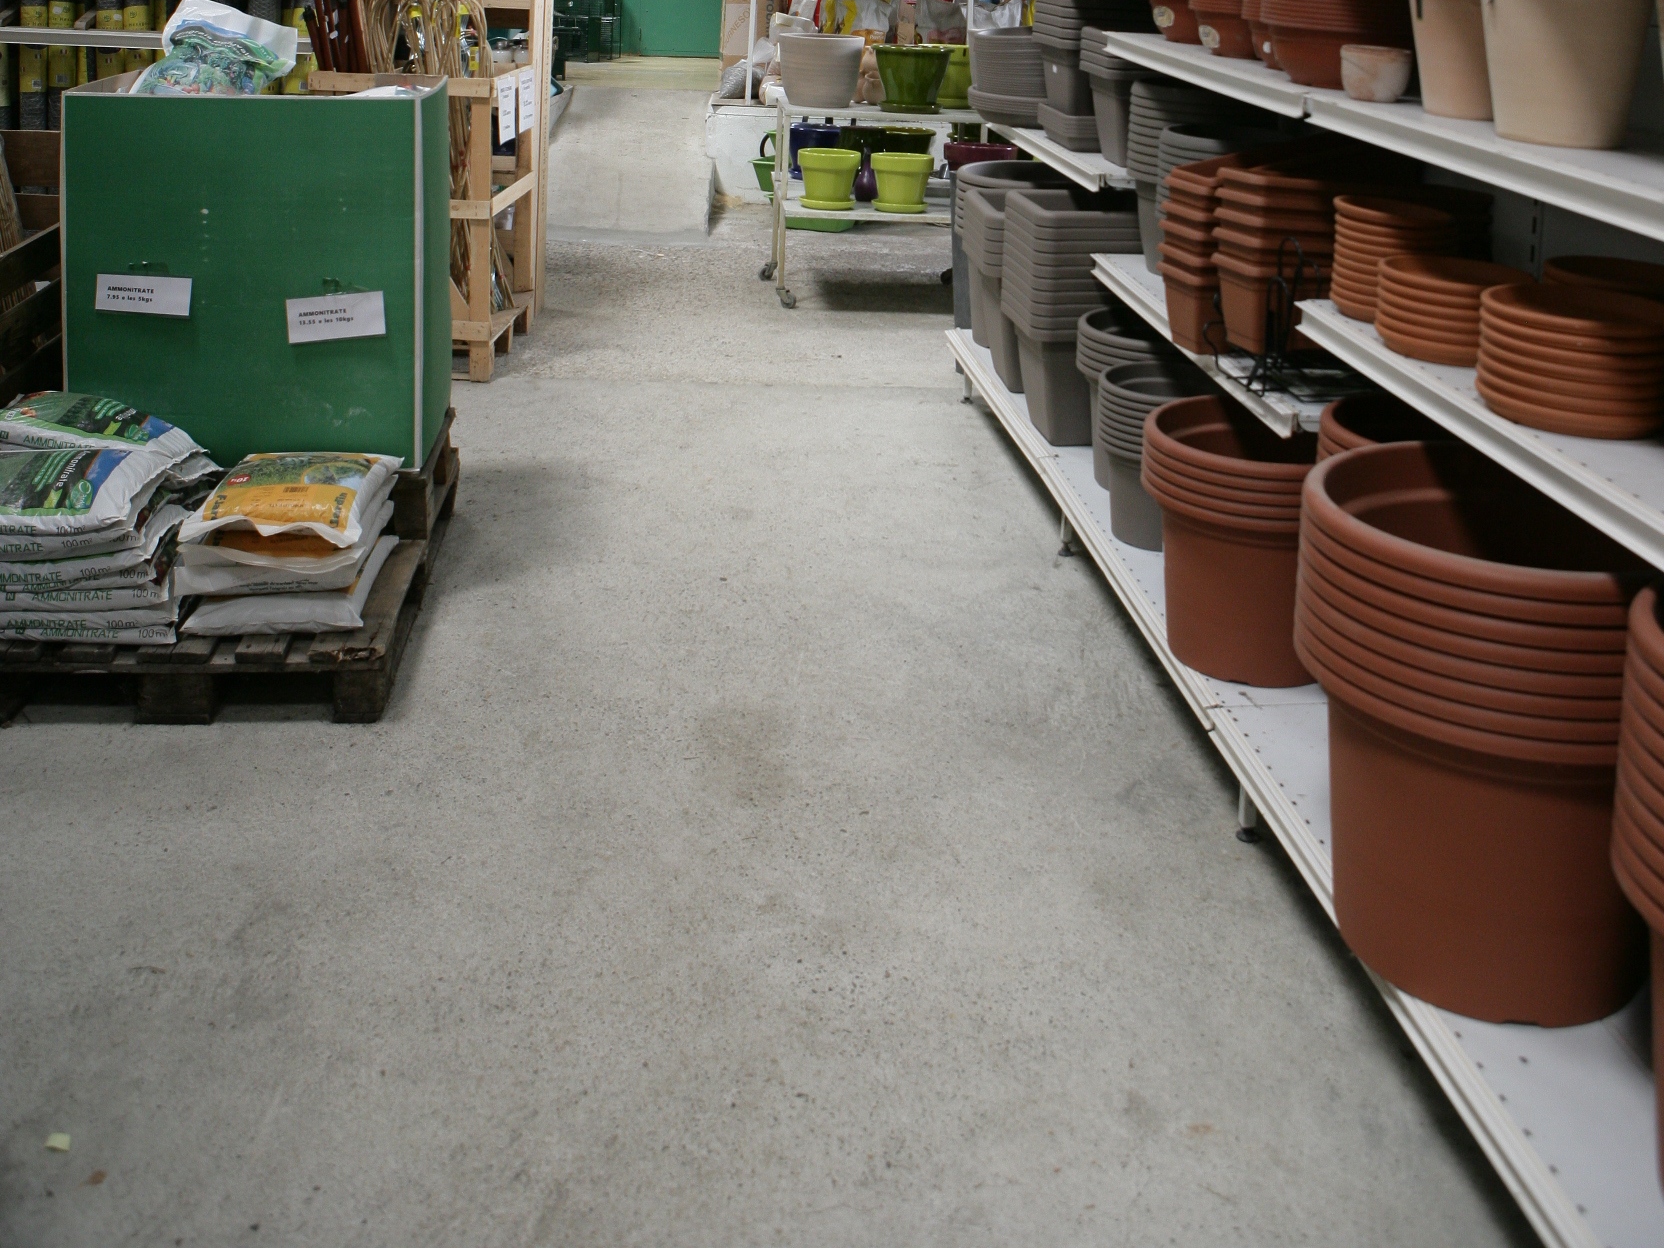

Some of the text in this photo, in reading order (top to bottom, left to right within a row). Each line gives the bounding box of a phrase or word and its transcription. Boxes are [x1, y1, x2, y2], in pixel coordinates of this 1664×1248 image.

[107, 285, 155, 294] AMMONITRATE
[298, 308, 347, 318] AMMONITRATE
[23, 435, 95, 449] AMMONITR
[31, 590, 112, 602] AMMONITRATE
[41, 628, 119, 639] AMMONITRATE
